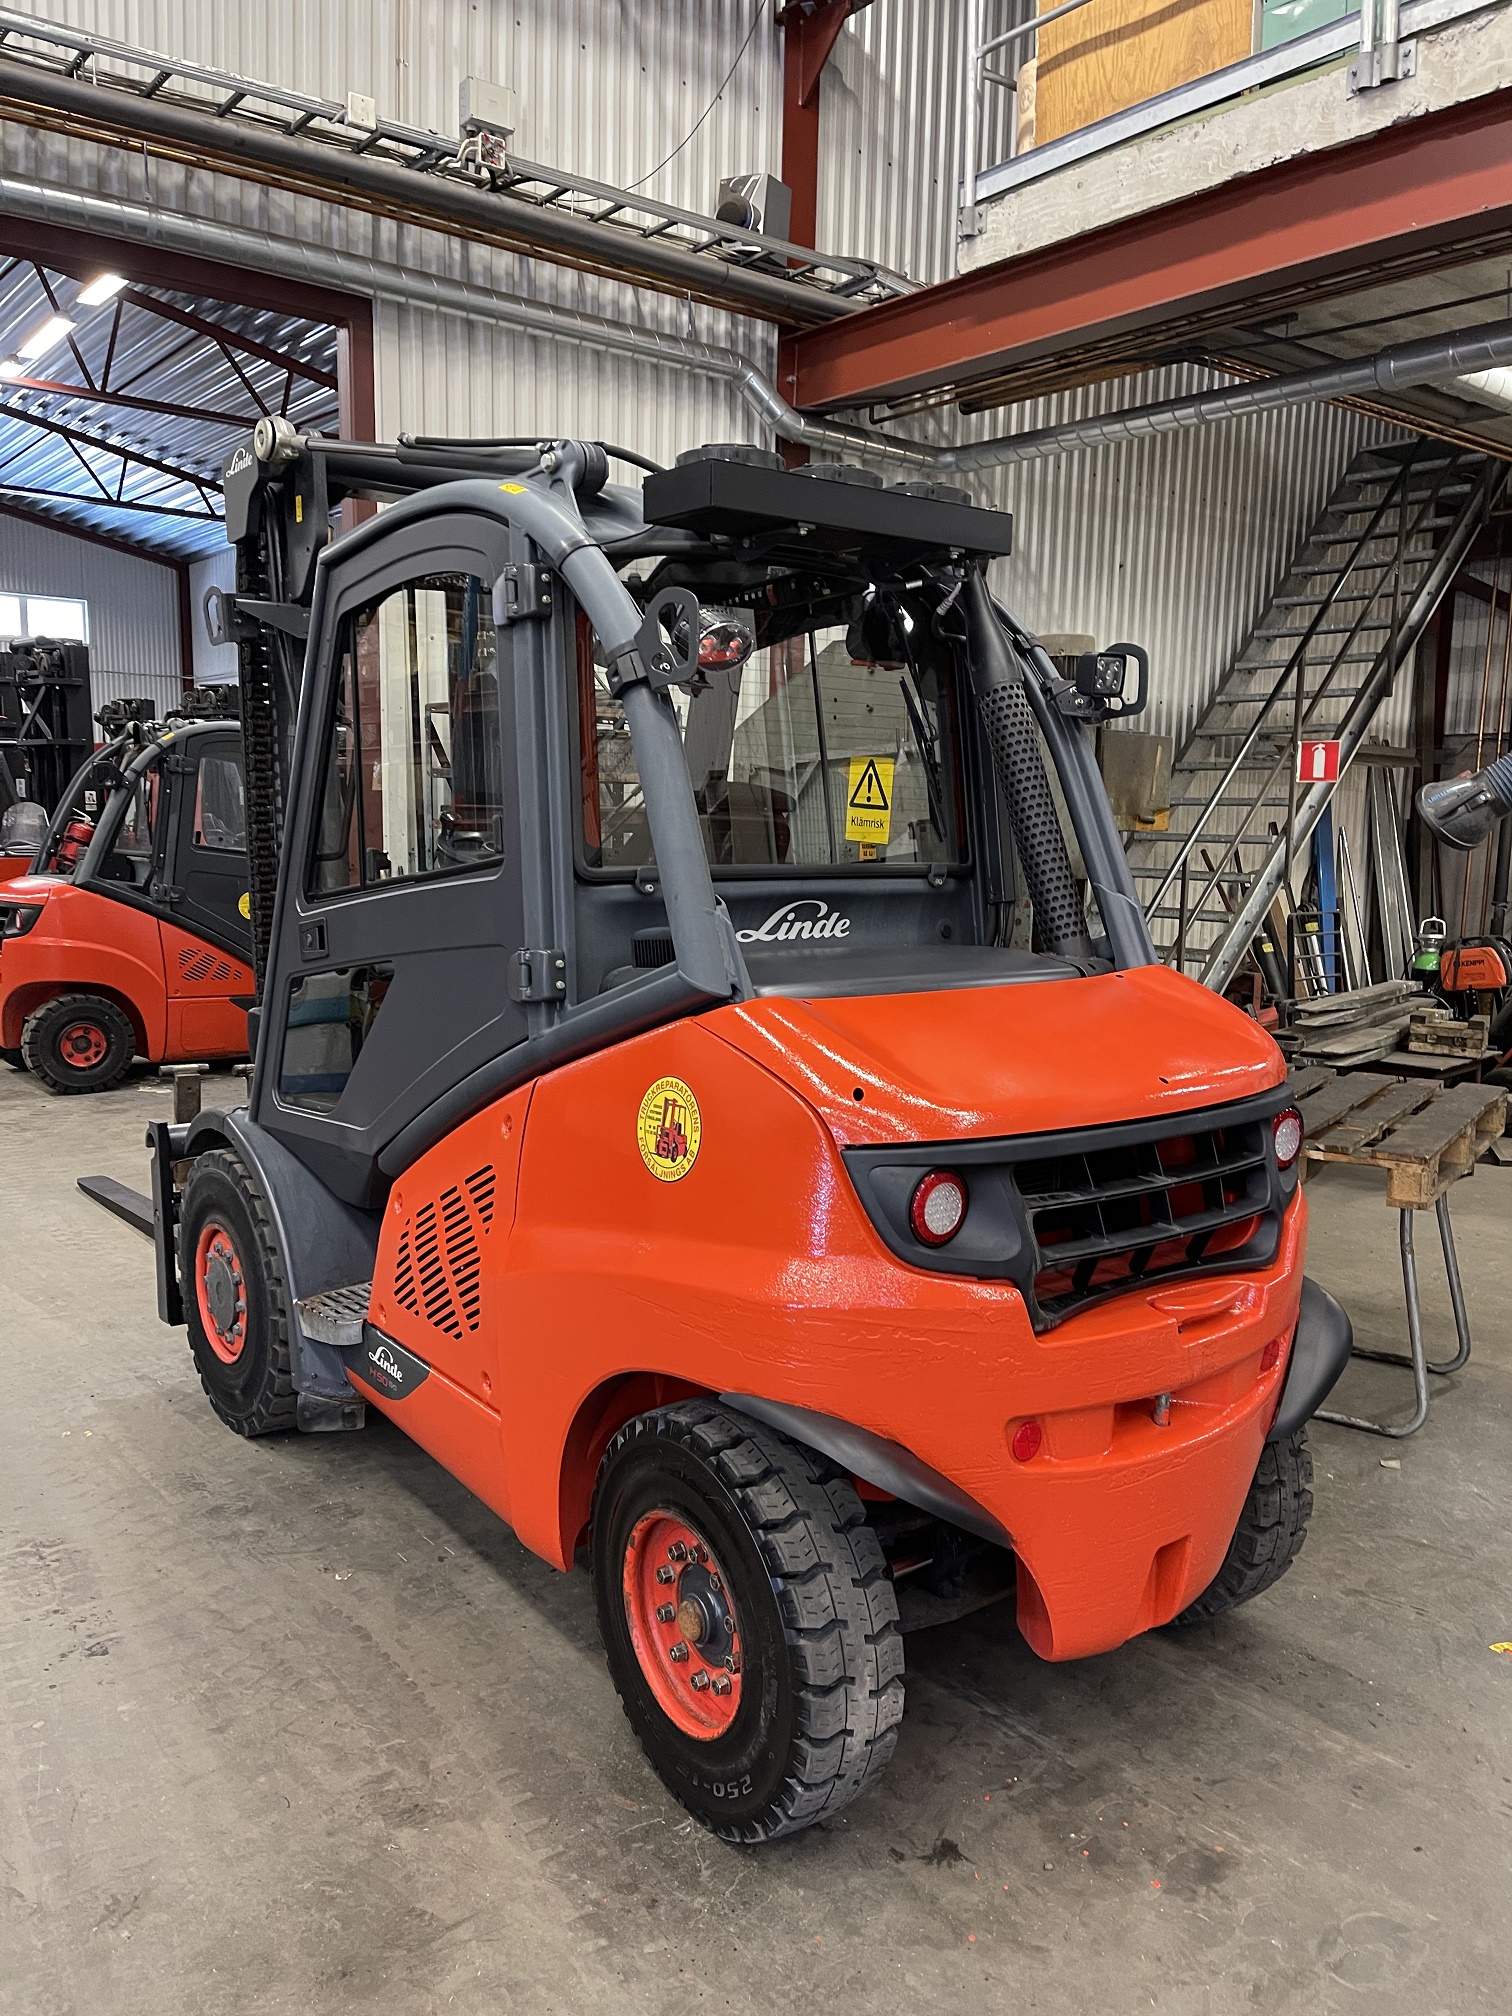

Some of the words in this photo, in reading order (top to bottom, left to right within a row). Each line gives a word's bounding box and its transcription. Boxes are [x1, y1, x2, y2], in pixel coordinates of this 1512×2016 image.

[225, 447, 253, 478] Linde
[850, 815, 885, 830] Klämrisk
[735, 899, 851, 943] Linde
[368, 1345, 403, 1383] Linde
